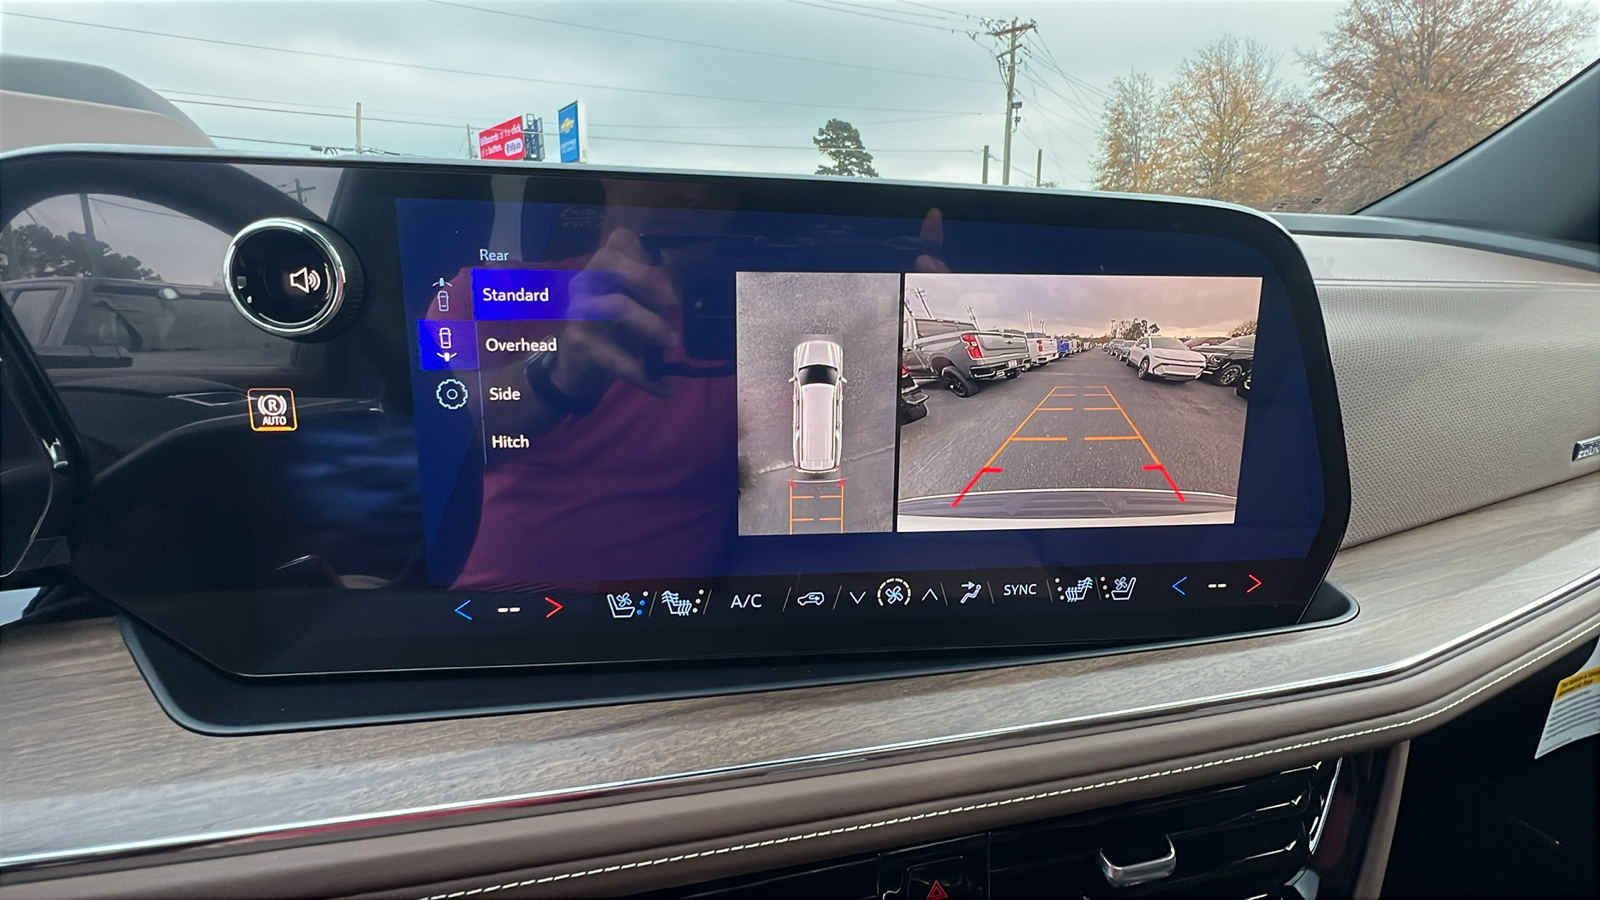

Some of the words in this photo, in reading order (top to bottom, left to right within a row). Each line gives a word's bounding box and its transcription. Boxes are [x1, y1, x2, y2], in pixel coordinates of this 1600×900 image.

[479, 249, 509, 261] Rear
[482, 287, 549, 302] Standard
[485, 337, 557, 352] Overhead
[489, 386, 521, 401] Side
[267, 399, 278, 411] R
[262, 416, 287, 426] AUTO
[491, 435, 530, 449] Hitch
[1003, 583, 1037, 597] SYNC
[730, 593, 763, 609] A/C
